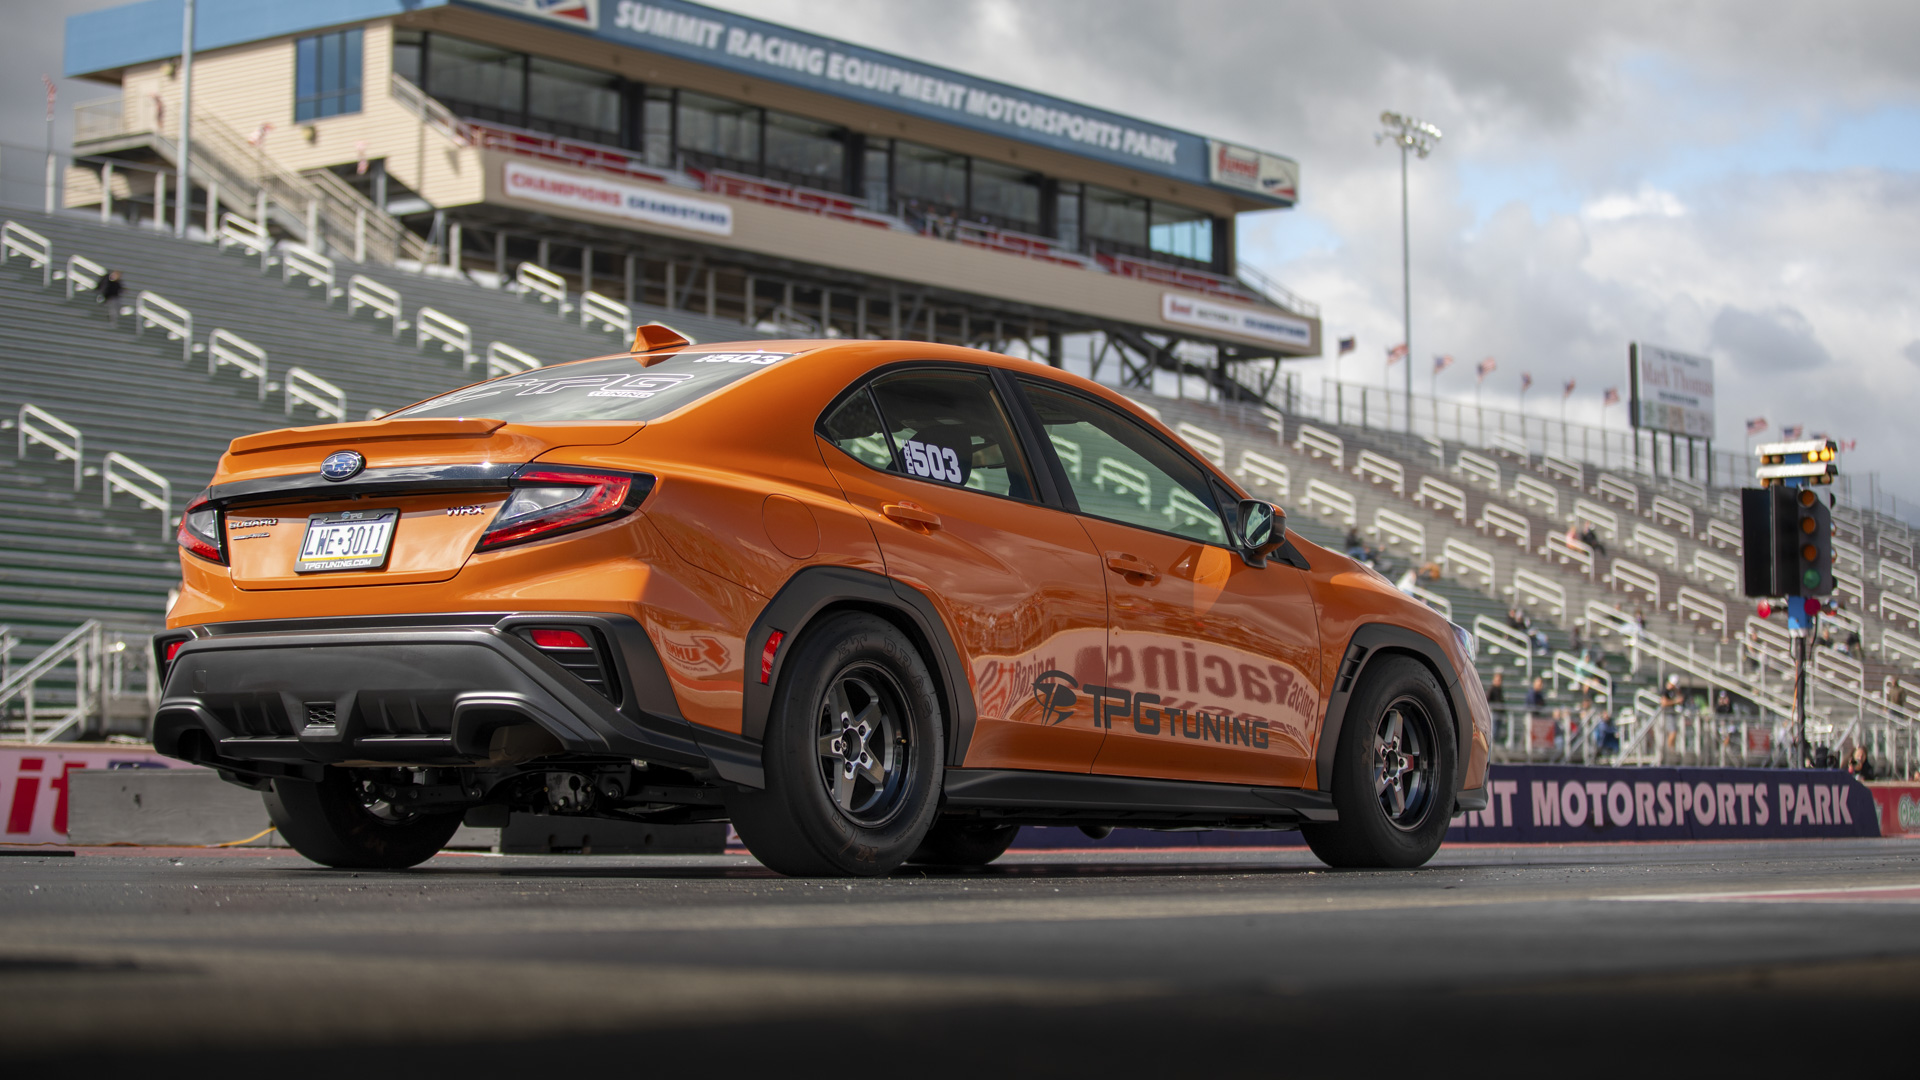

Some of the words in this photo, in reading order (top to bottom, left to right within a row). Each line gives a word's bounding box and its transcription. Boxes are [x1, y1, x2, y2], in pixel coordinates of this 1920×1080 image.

[614, 0, 725, 50] SUMMIT
[726, 28, 824, 76] RACING
[827, 53, 966, 110] EQUIPMENT
[967, 89, 1122, 150] MOTORSPORTS
[1123, 129, 1178, 165] PARK
[511, 171, 622, 207] CHAMPIONS
[908, 440, 962, 484] 503
[228, 518, 279, 529] SUBARU
[446, 504, 486, 517] WRX
[304, 558, 373, 570] TPGTUNING.COM
[1531, 780, 1771, 828] MOTORSPORTS
[1778, 784, 1853, 826] PARK
